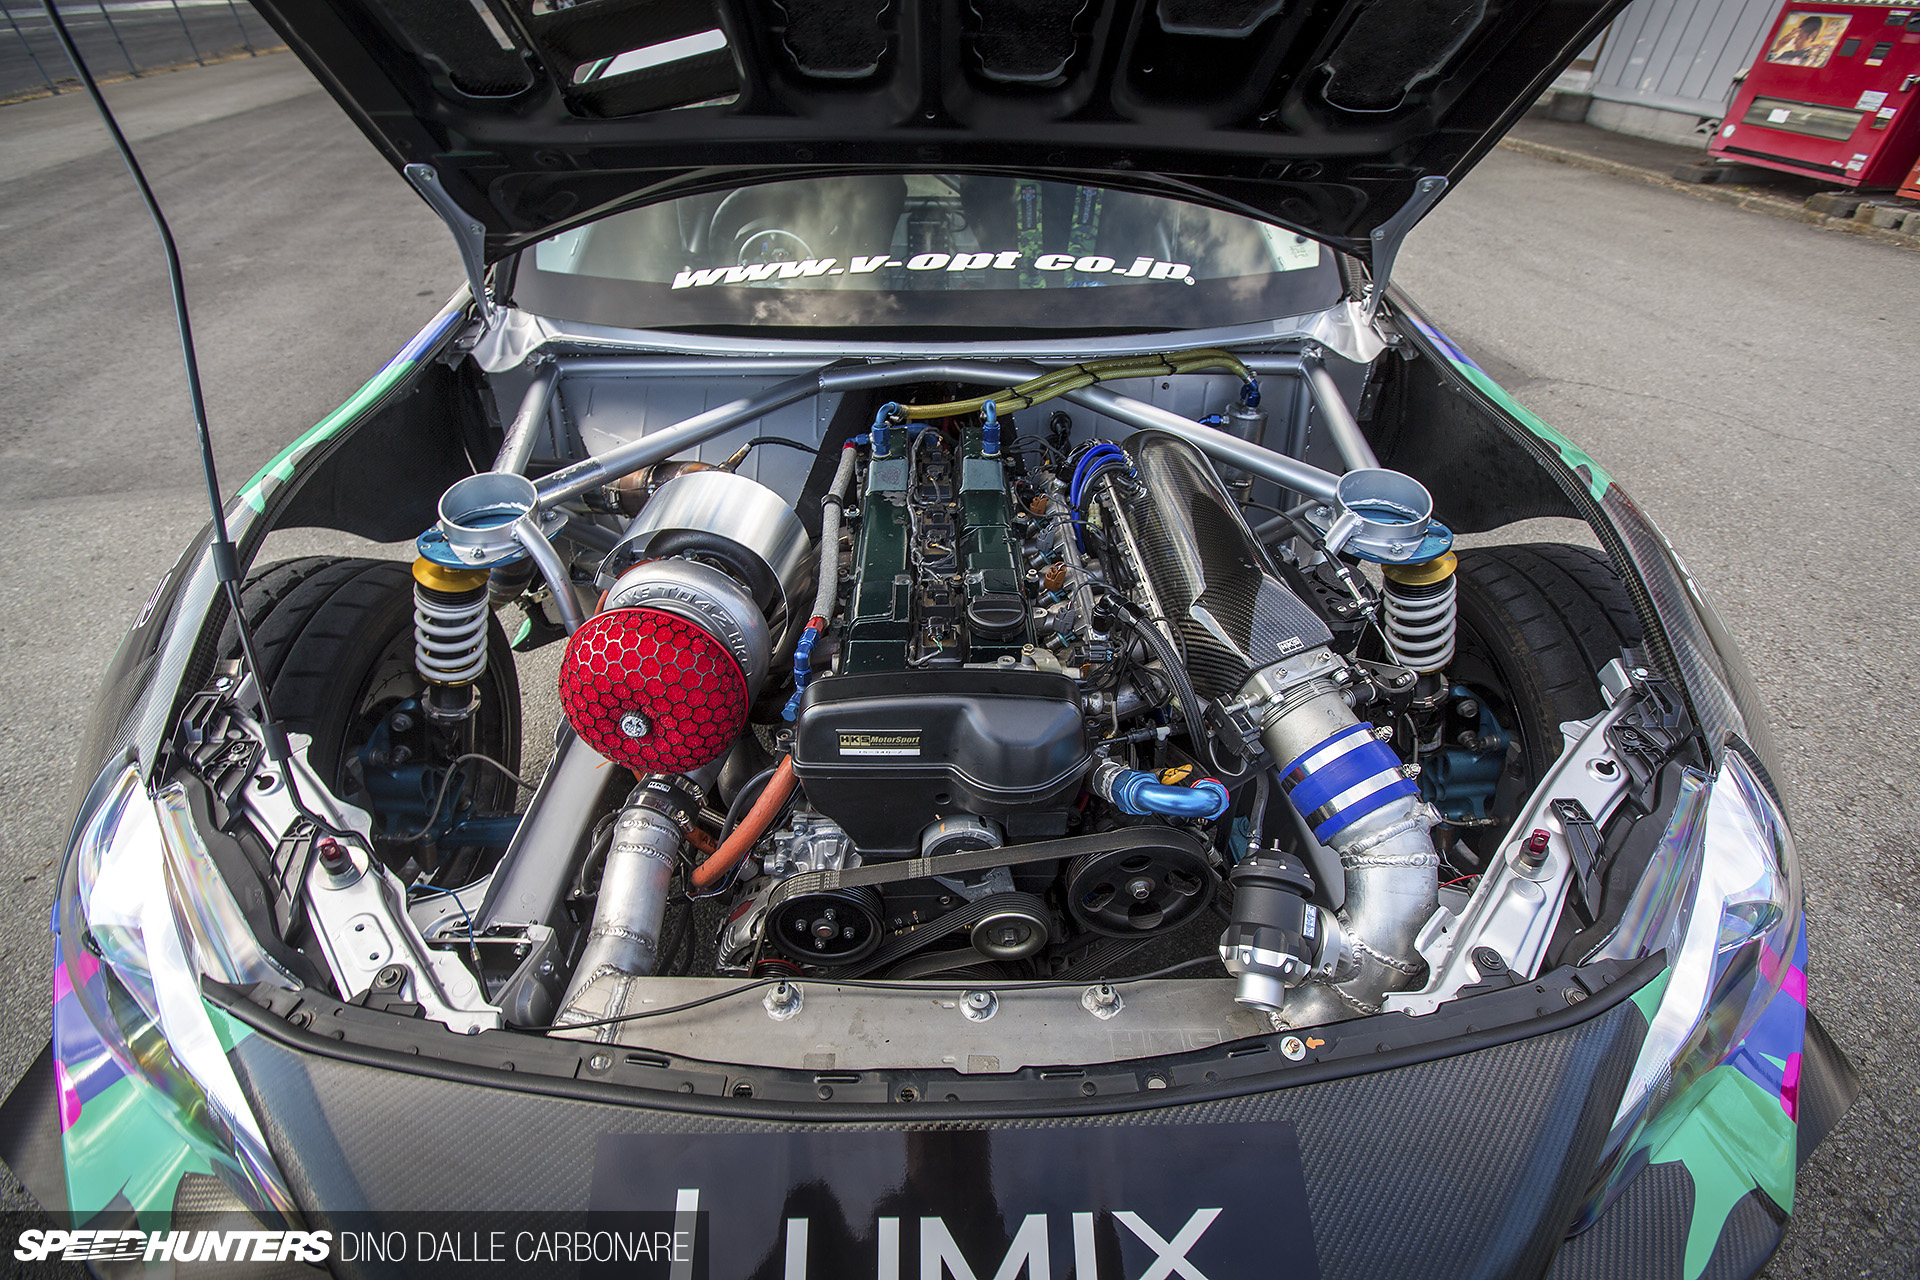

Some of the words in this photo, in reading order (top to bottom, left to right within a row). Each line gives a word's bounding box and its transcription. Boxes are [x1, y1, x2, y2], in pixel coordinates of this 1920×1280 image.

[671, 250, 1022, 290] www.v-opt
[1034, 254, 1192, 280] co.jp
[840, 735, 870, 746] HKS
[870, 736, 920, 745] MotorSport
